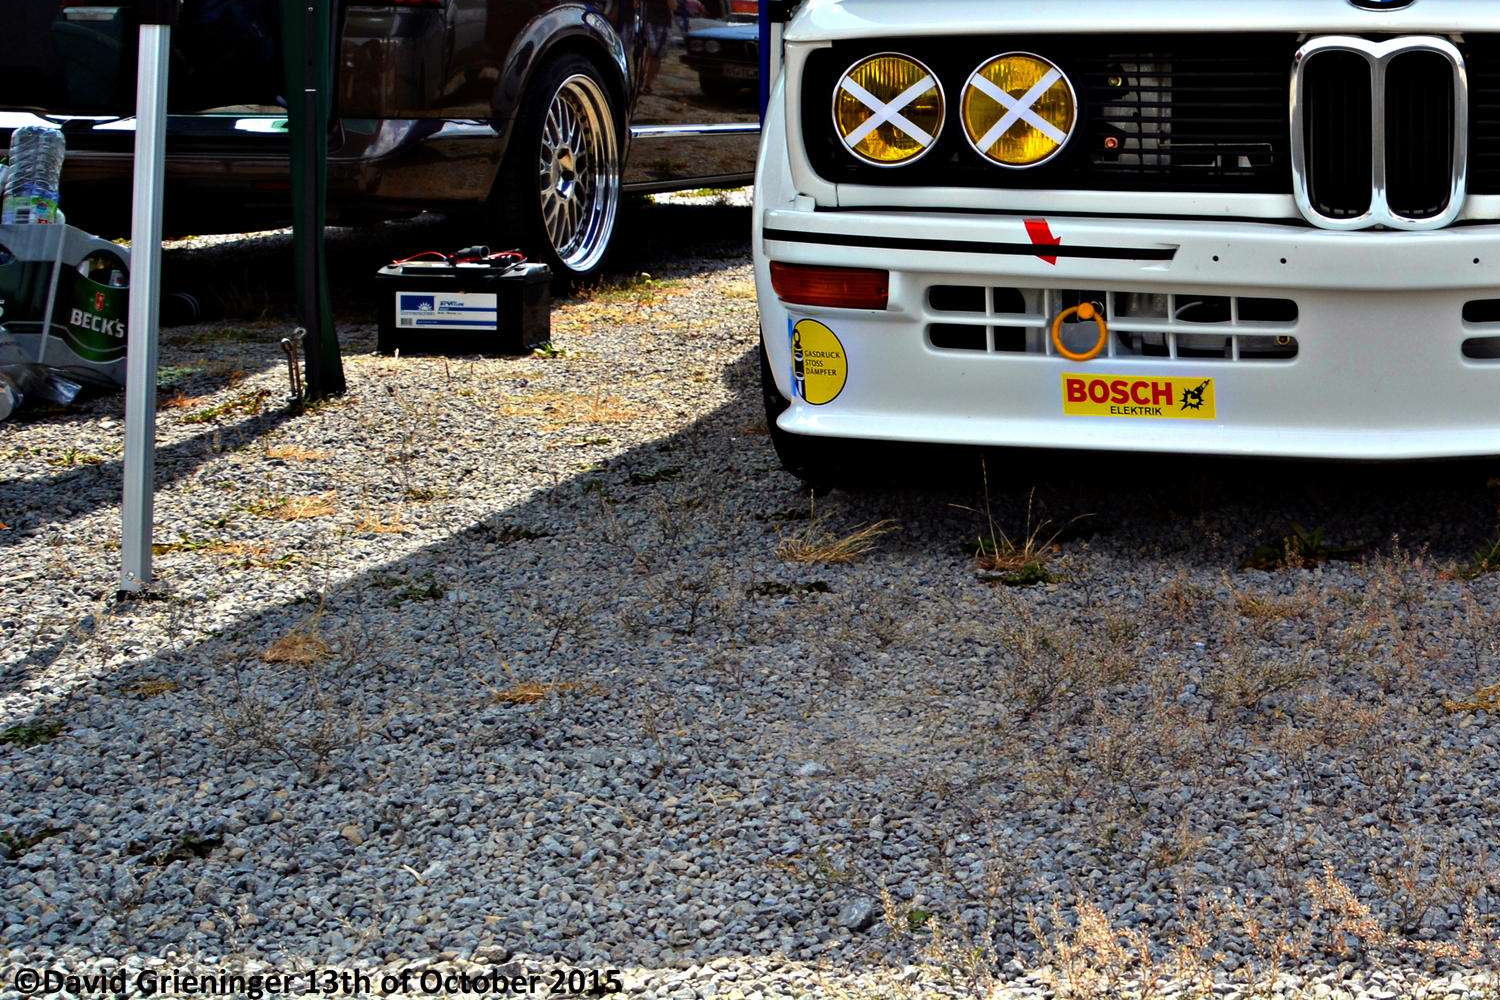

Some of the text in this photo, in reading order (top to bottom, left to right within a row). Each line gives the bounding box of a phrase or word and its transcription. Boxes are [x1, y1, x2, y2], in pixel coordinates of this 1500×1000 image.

[69, 307, 125, 338] BECK'S
[804, 350, 841, 359] GASDRUCK
[804, 359, 824, 367] STOSS
[1065, 378, 1174, 407] BOSCH
[1109, 405, 1163, 417] ELEKTRIK
